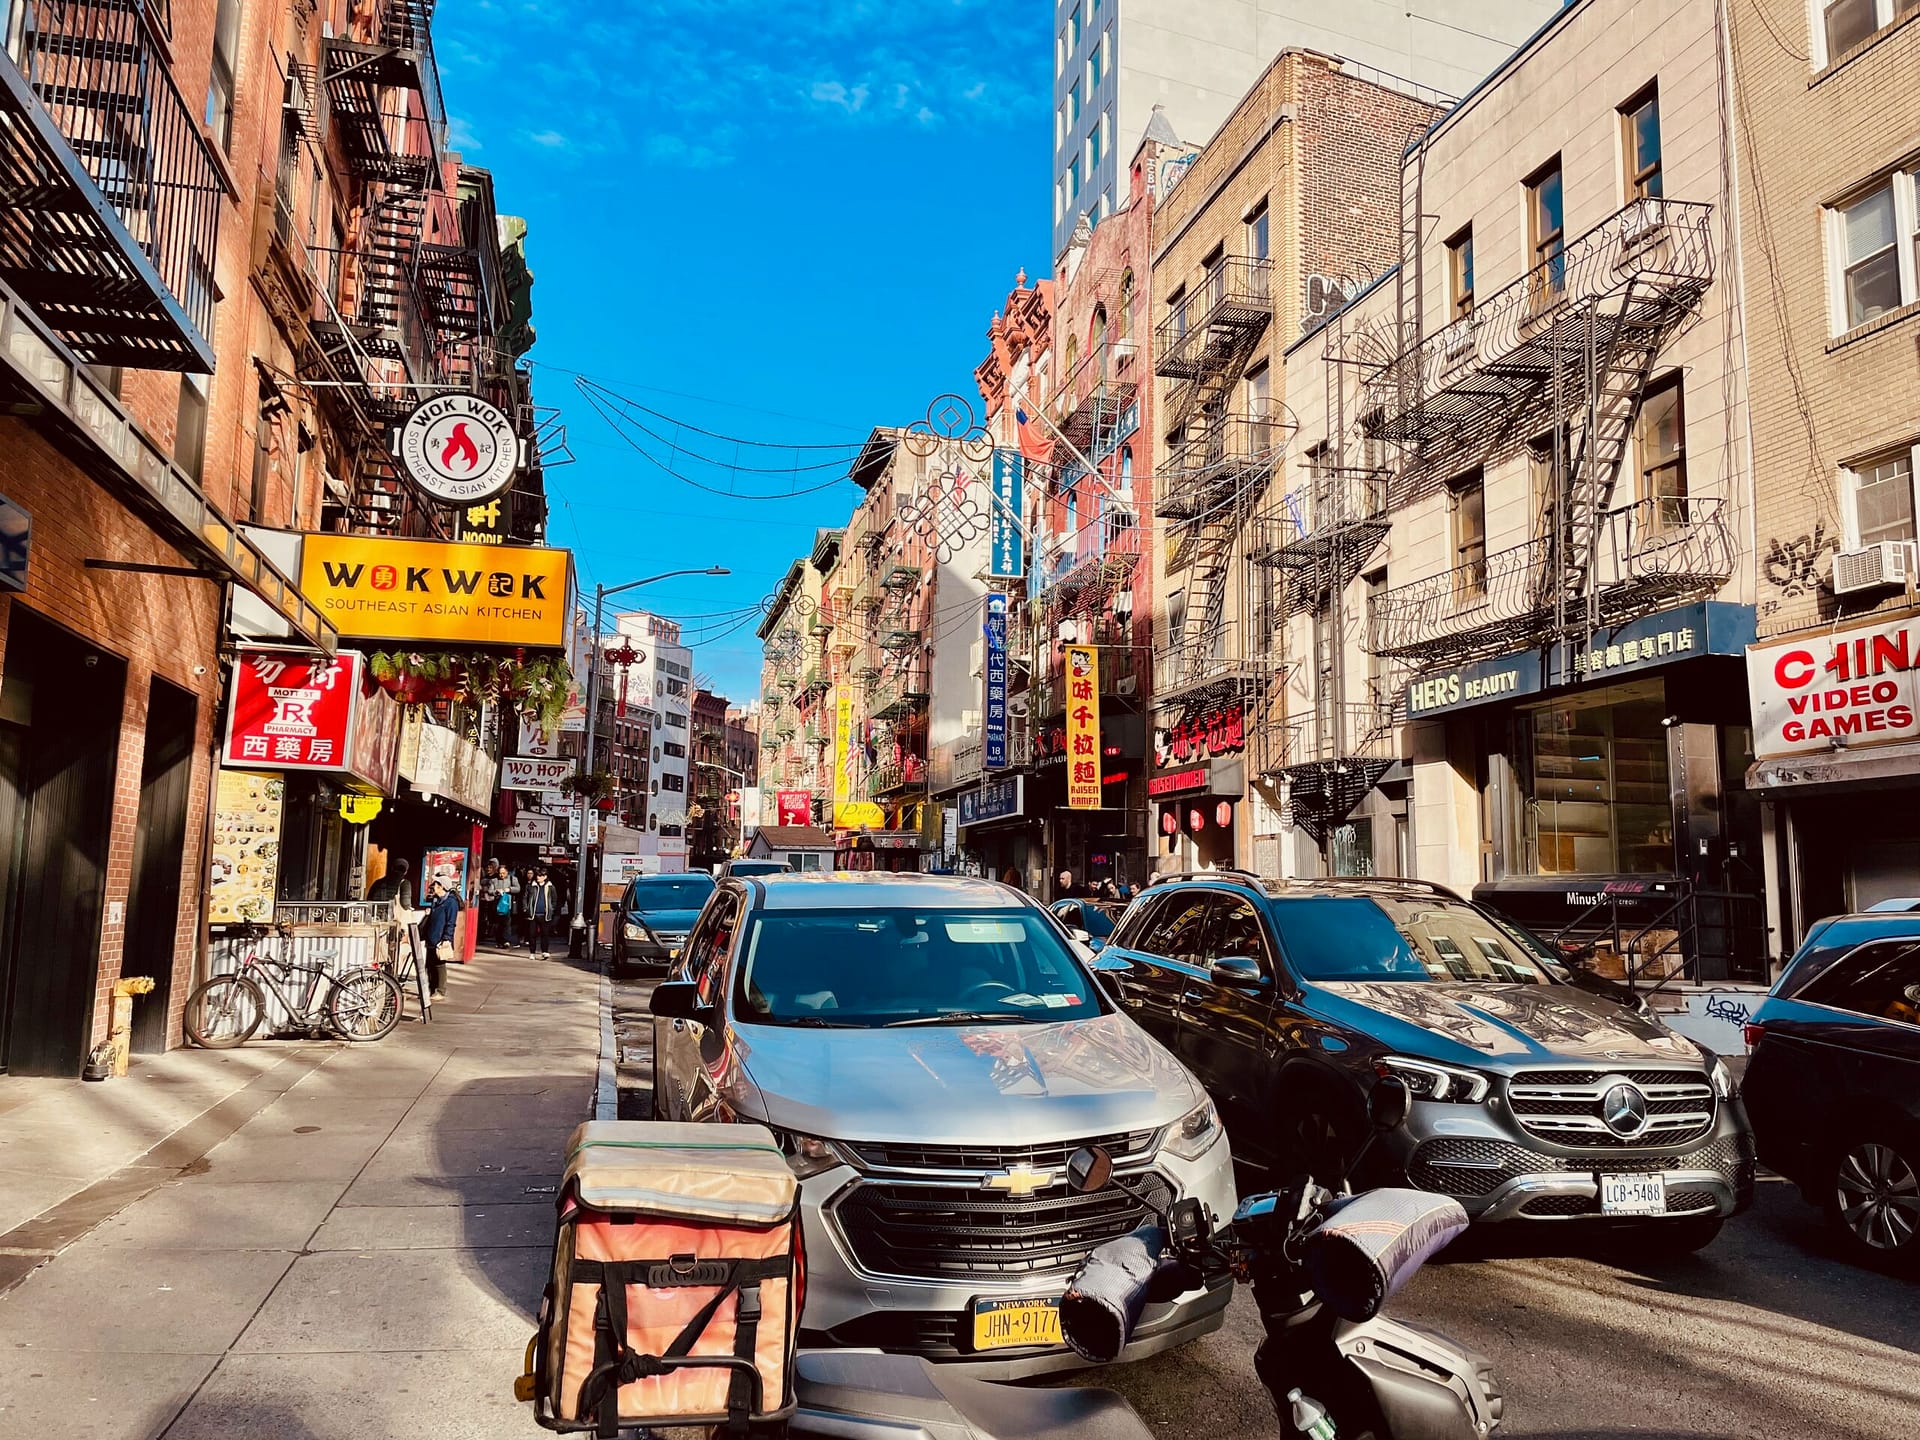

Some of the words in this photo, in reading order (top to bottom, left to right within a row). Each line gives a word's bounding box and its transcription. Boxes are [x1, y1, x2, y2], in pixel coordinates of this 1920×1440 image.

[413, 399, 457, 428] WOK
[467, 400, 508, 435] WOK
[408, 430, 446, 490] SOUTHEAST
[449, 482, 486, 495] ASIAN
[489, 438, 512, 484] KITCHEN
[325, 597, 419, 614] SOUTHEAST
[423, 603, 469, 616] ASIAN
[476, 606, 543, 620] KITCHEN
[1774, 630, 1920, 690] CHIN
[273, 689, 299, 697] MOTT
[1410, 674, 1460, 712] HERS
[1465, 671, 1518, 701] BEAUTY
[1787, 681, 1899, 715] VIDEO
[266, 725, 314, 735] PHARMACY
[1071, 679, 1095, 783] 味千拉麵
[1782, 705, 1914, 743] GAMES
[242, 735, 333, 762] 西藥房
[991, 746, 1001, 755] 18
[507, 762, 533, 775] WO
[537, 764, 566, 777] HOP
[529, 831, 546, 839] HOP
[1606, 1184, 1626, 1203] LCB
[1633, 1183, 1660, 1202] 5488
[998, 1301, 1021, 1310] NEW
[1022, 1299, 1047, 1309] YORK
[984, 1313, 1011, 1338] JHN
[1022, 1310, 1059, 1334] 9177
